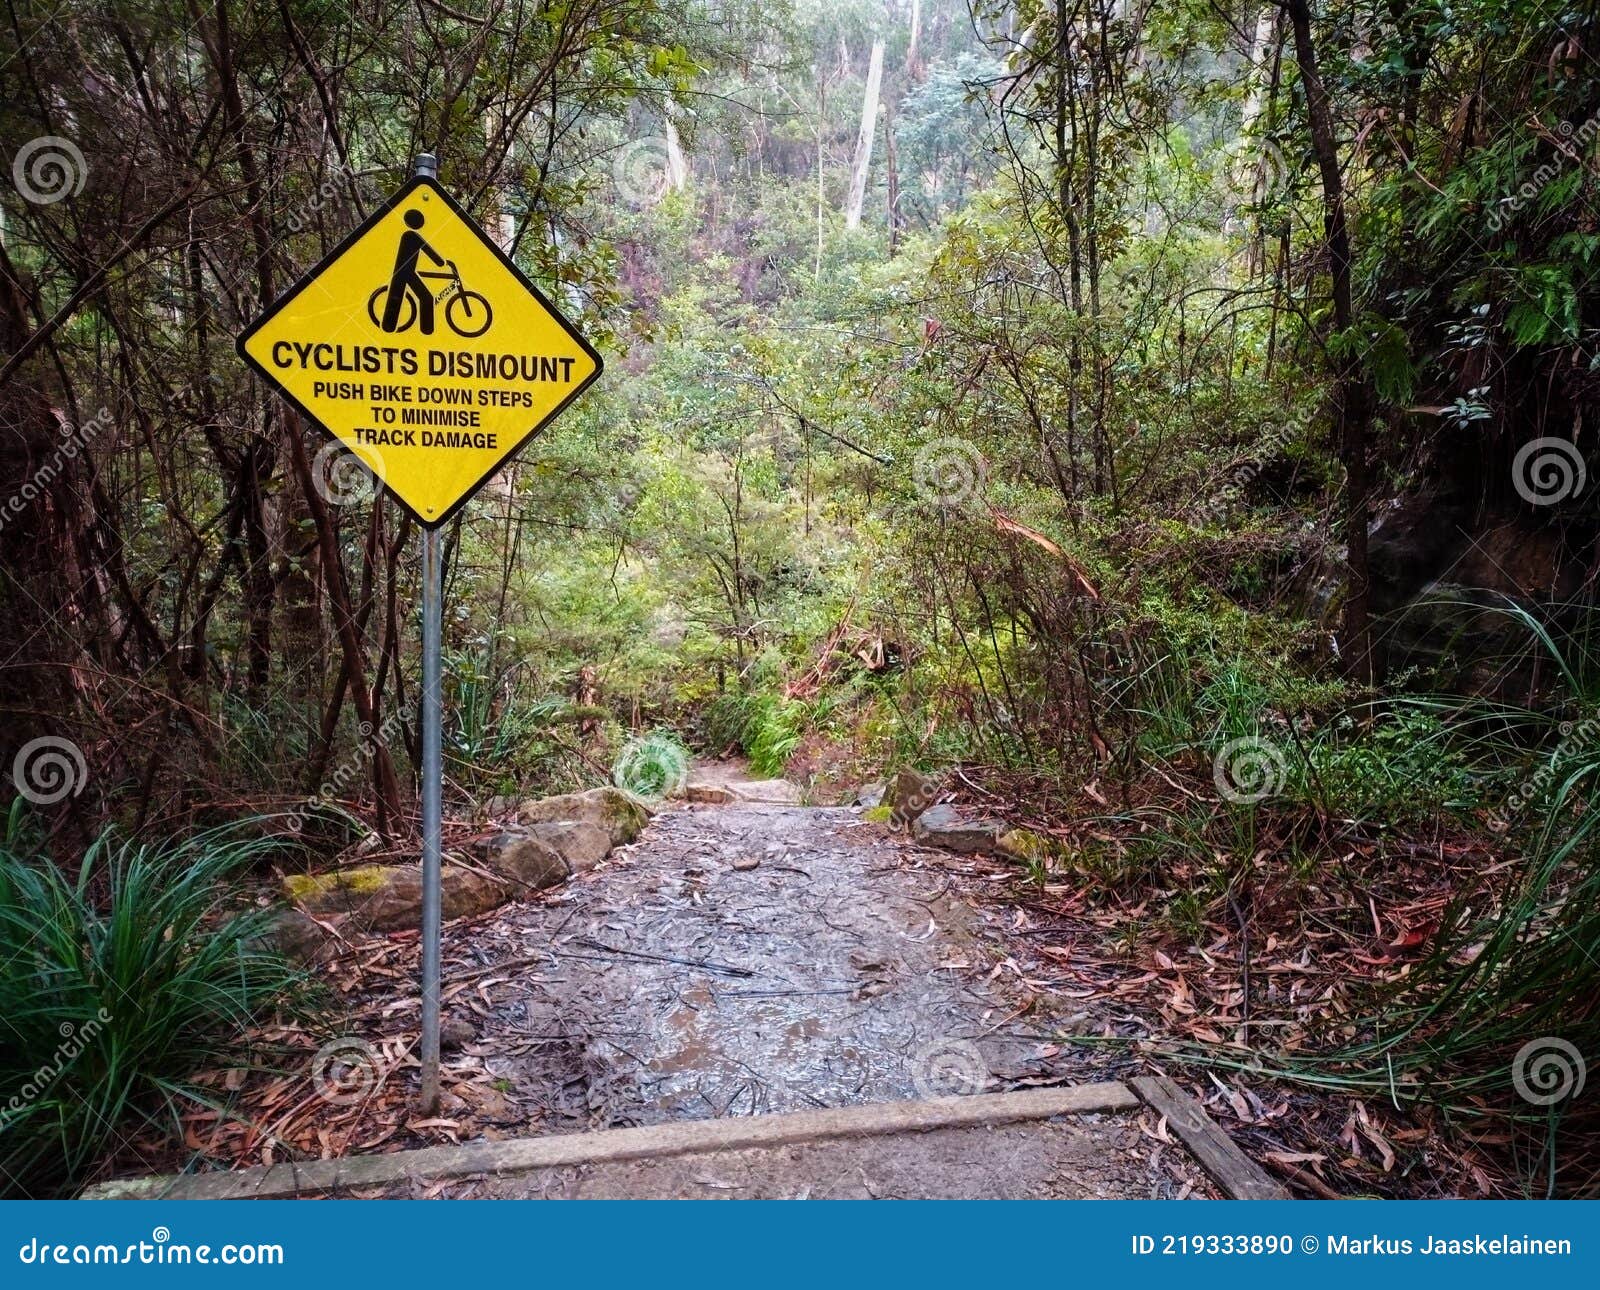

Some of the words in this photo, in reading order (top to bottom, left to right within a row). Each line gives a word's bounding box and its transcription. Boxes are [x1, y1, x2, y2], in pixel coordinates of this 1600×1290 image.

[271, 340, 419, 376] CYCLISTS
[428, 350, 576, 383] DISMOUNT
[313, 381, 364, 401] PUSH
[370, 384, 413, 403] BIKE
[417, 387, 473, 406] DOWN
[477, 389, 533, 408] STEPS
[370, 406, 396, 424] TO
[401, 408, 481, 428] MINIMISE
[353, 428, 417, 447] TRACK
[421, 430, 498, 450] DAMAGE
